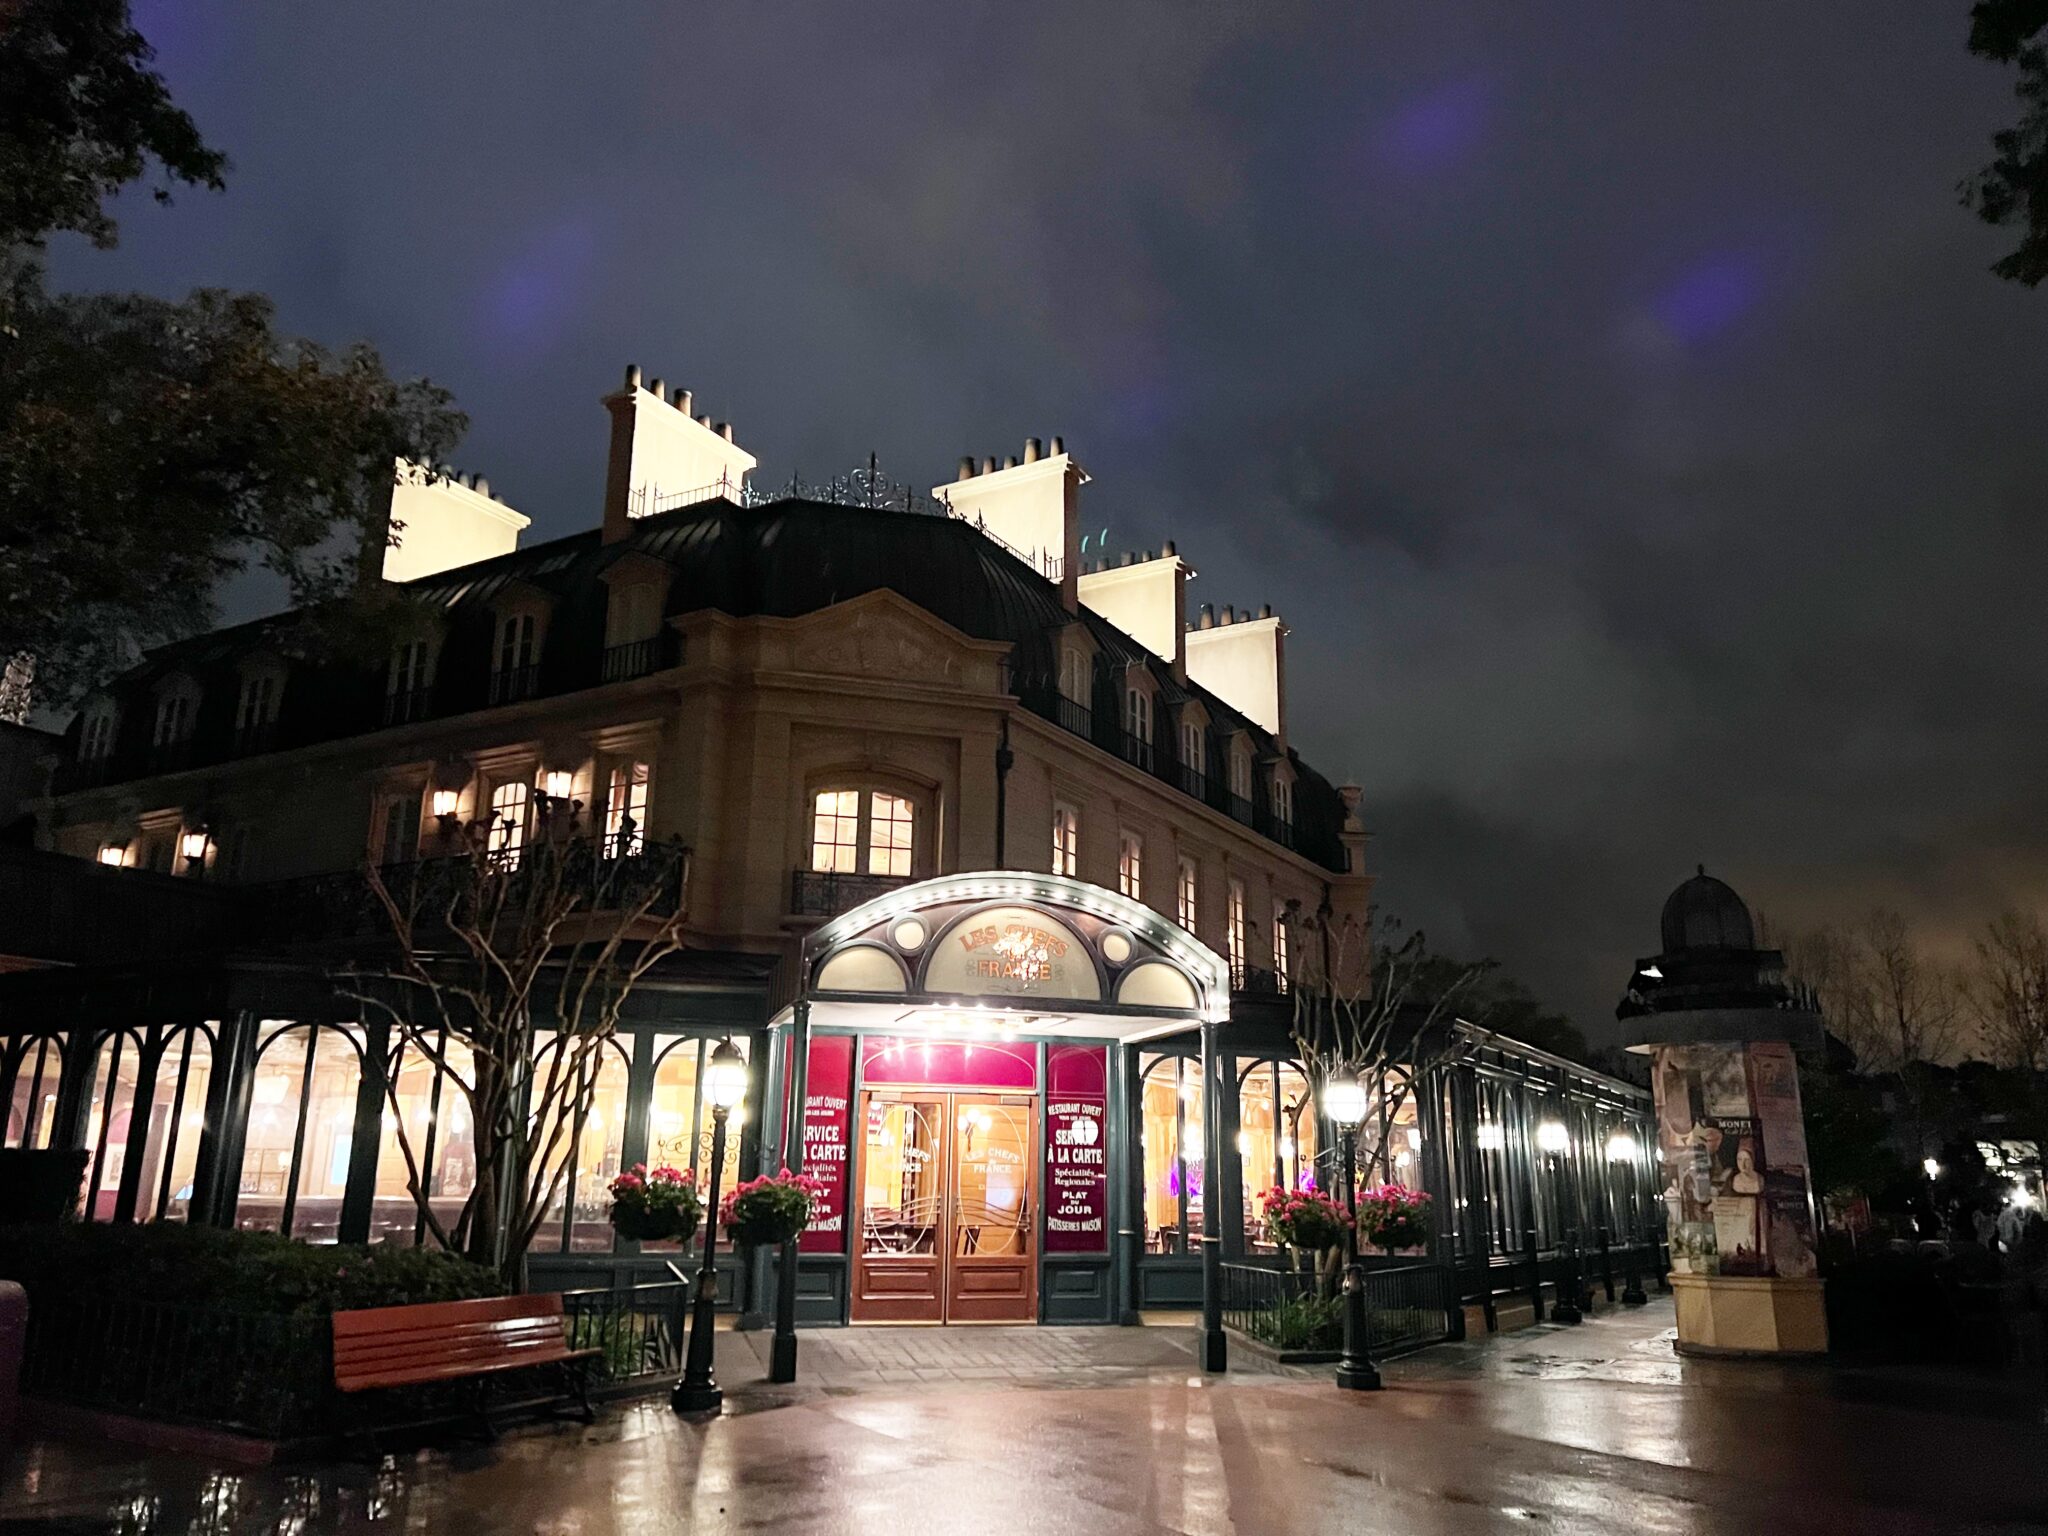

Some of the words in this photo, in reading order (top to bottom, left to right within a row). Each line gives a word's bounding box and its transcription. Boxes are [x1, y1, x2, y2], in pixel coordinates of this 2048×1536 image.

[959, 925, 998, 952] LES
[978, 960, 1051, 981] FRAE
[824, 1096, 847, 1110] OUVERT
[1048, 1103, 1080, 1116] RESTAURANT
[1082, 1104, 1102, 1117] OUVERT
[1718, 1120, 1751, 1128] MONET
[804, 1125, 839, 1142] RVICE
[810, 1144, 847, 1161] CARTE
[988, 1147, 1020, 1164] CHEFS
[1047, 1143, 1054, 1163] À
[1057, 1147, 1070, 1163] LA
[1072, 1148, 1103, 1164] CARTE
[973, 1165, 1012, 1174] FRANCE
[1055, 1168, 1095, 1178] Spécialités
[1062, 1191, 1088, 1199] PLAT
[1057, 1205, 1092, 1215] JOUR
[817, 1214, 842, 1231] MAISON
[1081, 1216, 1102, 1232] MAISON
